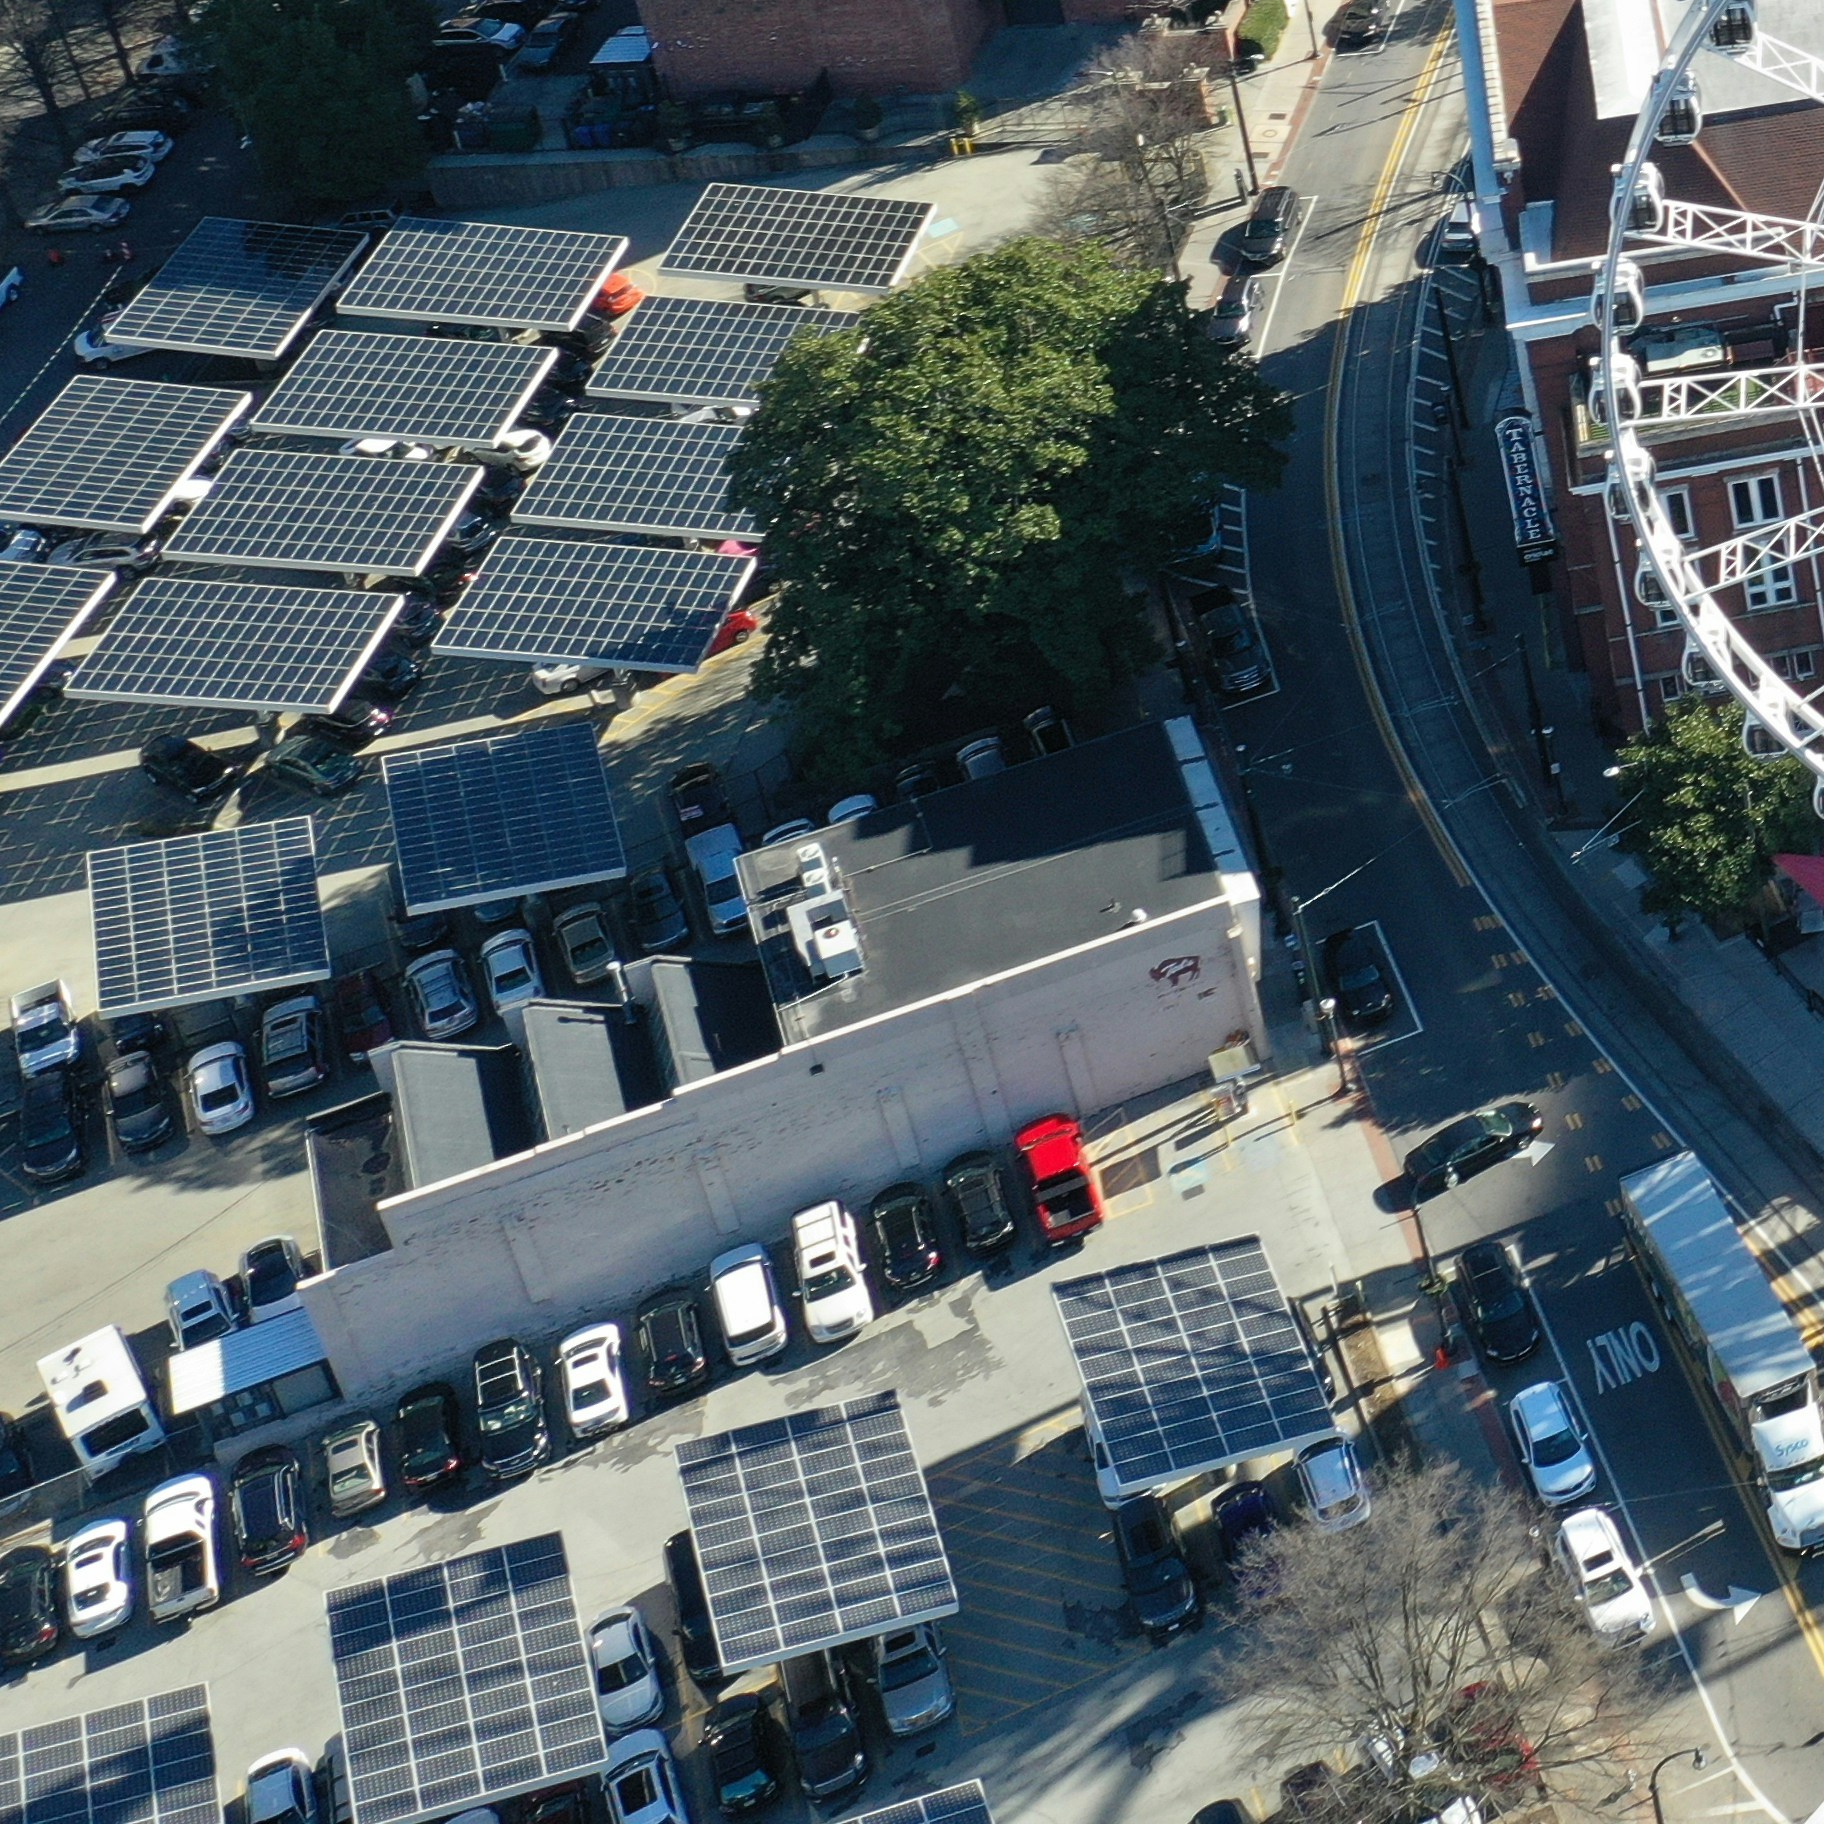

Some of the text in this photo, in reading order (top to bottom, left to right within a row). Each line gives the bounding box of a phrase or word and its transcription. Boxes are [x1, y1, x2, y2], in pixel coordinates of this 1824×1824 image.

[1505, 427, 1542, 541] TABERNACLE
[1586, 1320, 1661, 1395] ONLY
[1774, 1437, 1809, 1458] Sysco
